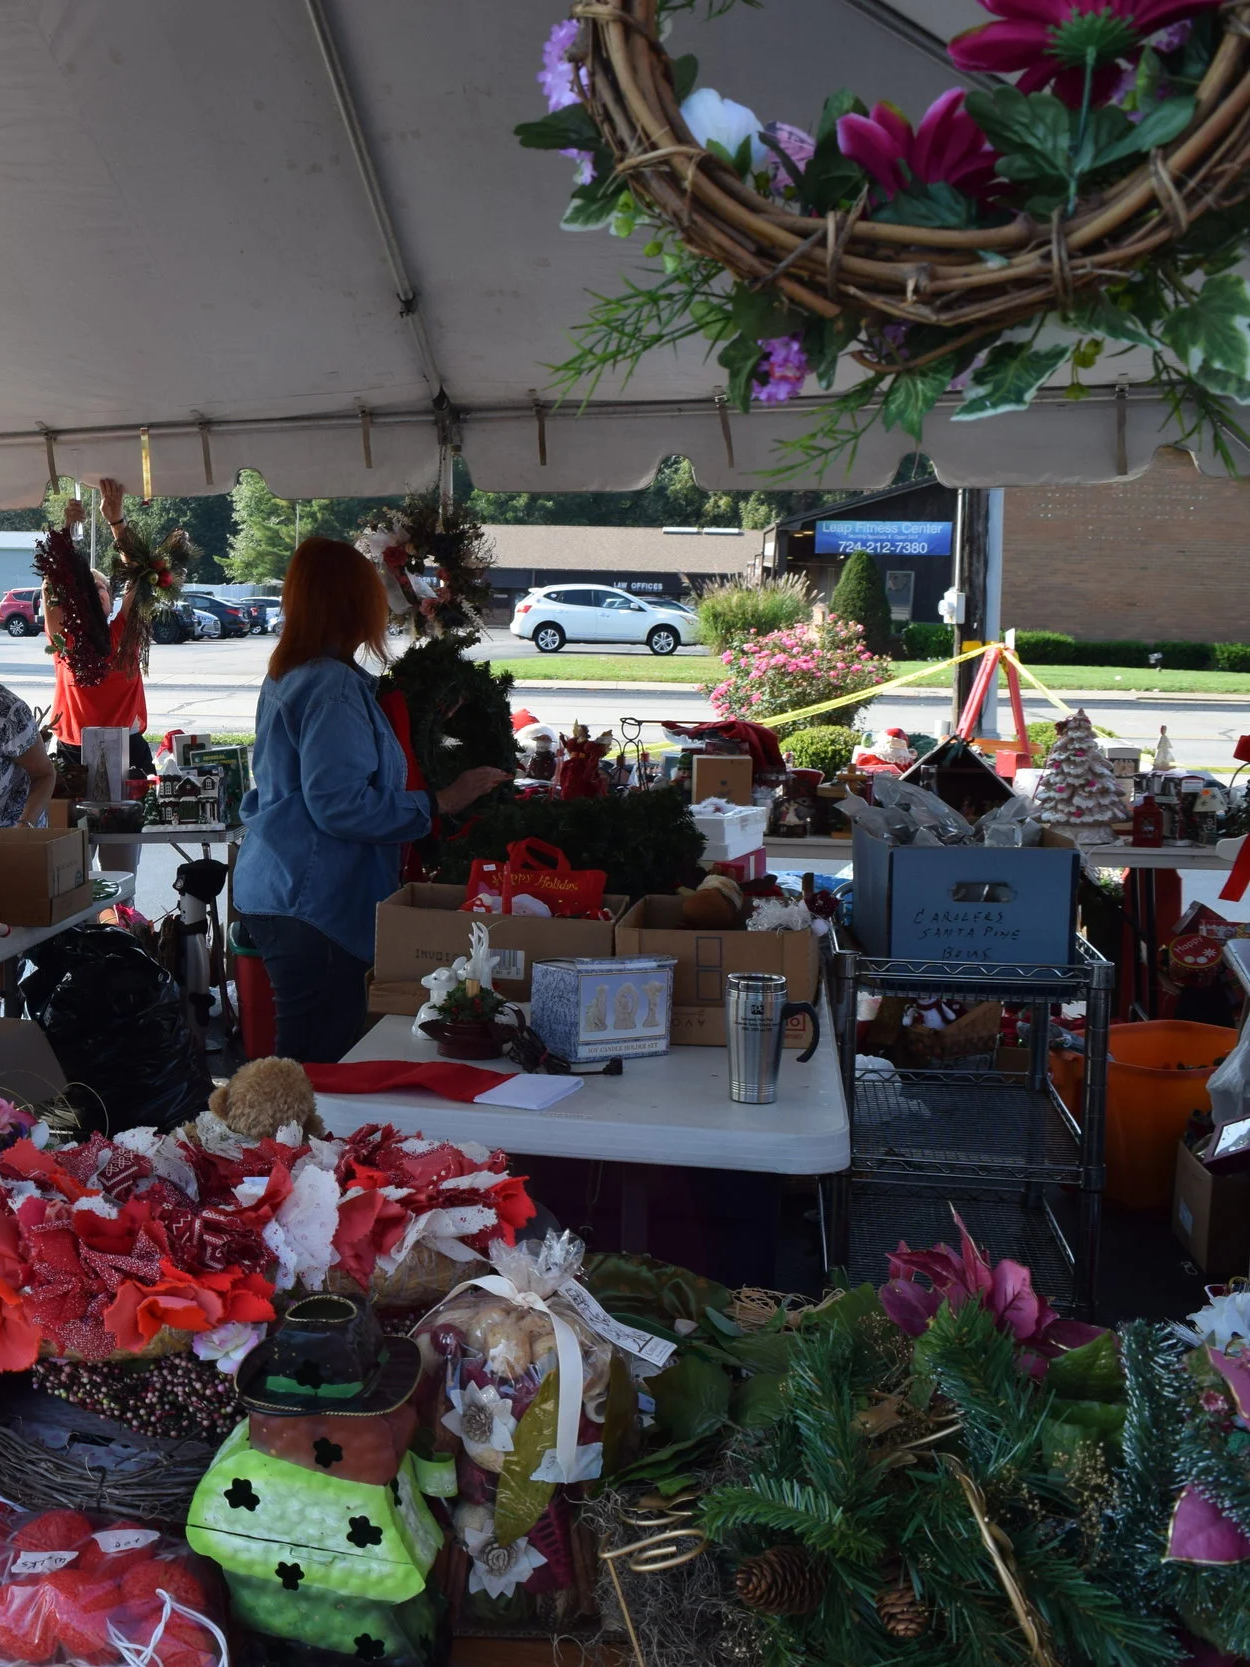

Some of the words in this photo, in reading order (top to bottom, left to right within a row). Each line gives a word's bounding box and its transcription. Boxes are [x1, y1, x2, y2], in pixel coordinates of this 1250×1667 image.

[822, 522, 852, 534] Leap
[855, 522, 898, 533] Fitness
[901, 522, 943, 534] Center
[838, 541, 928, 554] 724-212-7380
[631, 582, 663, 590] OFFICES
[492, 872, 533, 887] Hppy
[918, 927, 975, 940] SANTA
[1173, 936, 1204, 953] Happy
[671, 1019, 706, 1027] AVO
[600, 1045, 622, 1053] CANDLE
[624, 1043, 646, 1051] HOLDER
